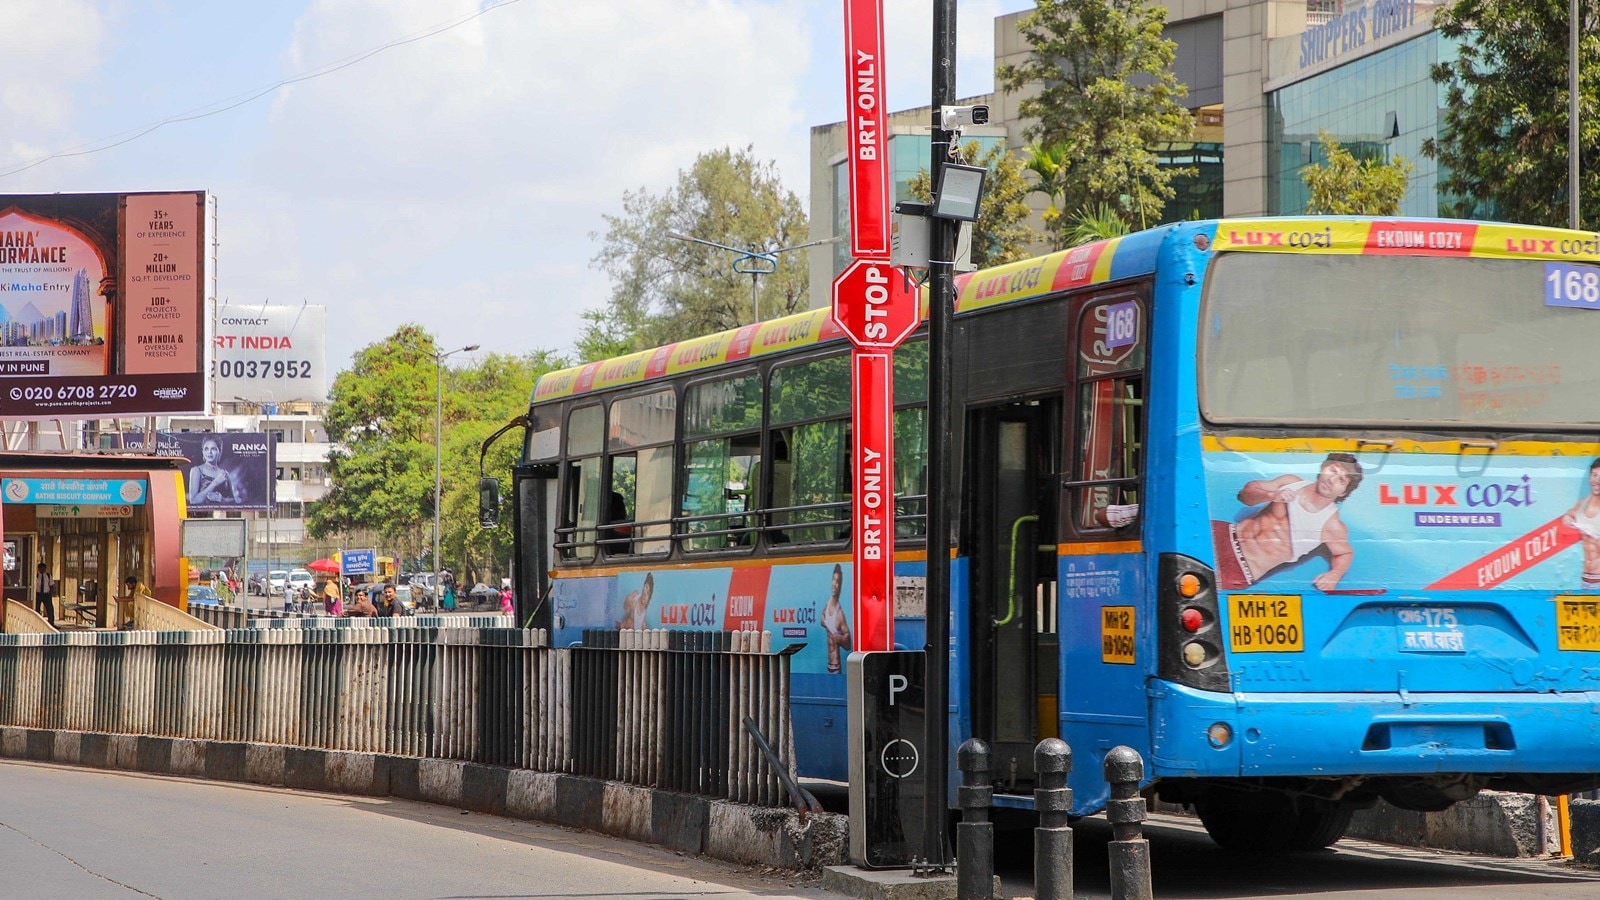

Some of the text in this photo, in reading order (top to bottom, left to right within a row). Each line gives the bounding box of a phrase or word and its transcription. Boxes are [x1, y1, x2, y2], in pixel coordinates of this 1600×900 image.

[1299, 6, 1367, 69] SHOPPERS
[857, 49, 876, 160] BRT ONLY
[153, 210, 168, 219] 35+
[149, 221, 174, 230] YEARS
[1230, 226, 1332, 248] LUX cozi
[1377, 230, 1462, 249] EKDUM COZY
[1505, 238, 1556, 253] LUX
[153, 253, 168, 262] 20+
[145, 264, 176, 273] MILLION
[975, 274, 1013, 301] LUX
[1547, 270, 1600, 302] 168
[151, 297, 170, 306] 100+
[864, 266, 888, 340] STOP
[1107, 308, 1135, 342] 168
[138, 334, 184, 344] PAN INDIA &
[241, 336, 292, 349] INDIA
[24, 385, 137, 400] 020 6708 2720
[232, 443, 267, 451] RANKA
[1378, 474, 1537, 507] LUX cozi
[864, 447, 881, 560] BRT ONLY
[1419, 515, 1495, 524] UNDERWEAR
[1477, 526, 1558, 587] EKDUM COZY
[661, 593, 716, 626] LUX cozi
[730, 596, 754, 617] EKDUM
[773, 601, 816, 624] LUX cozi
[1238, 601, 1288, 618] MH 12
[1120, 611, 1130, 630] 12
[1113, 635, 1134, 656] 1060
[1232, 624, 1298, 646] HB 1060
[889, 674, 908, 706] P
